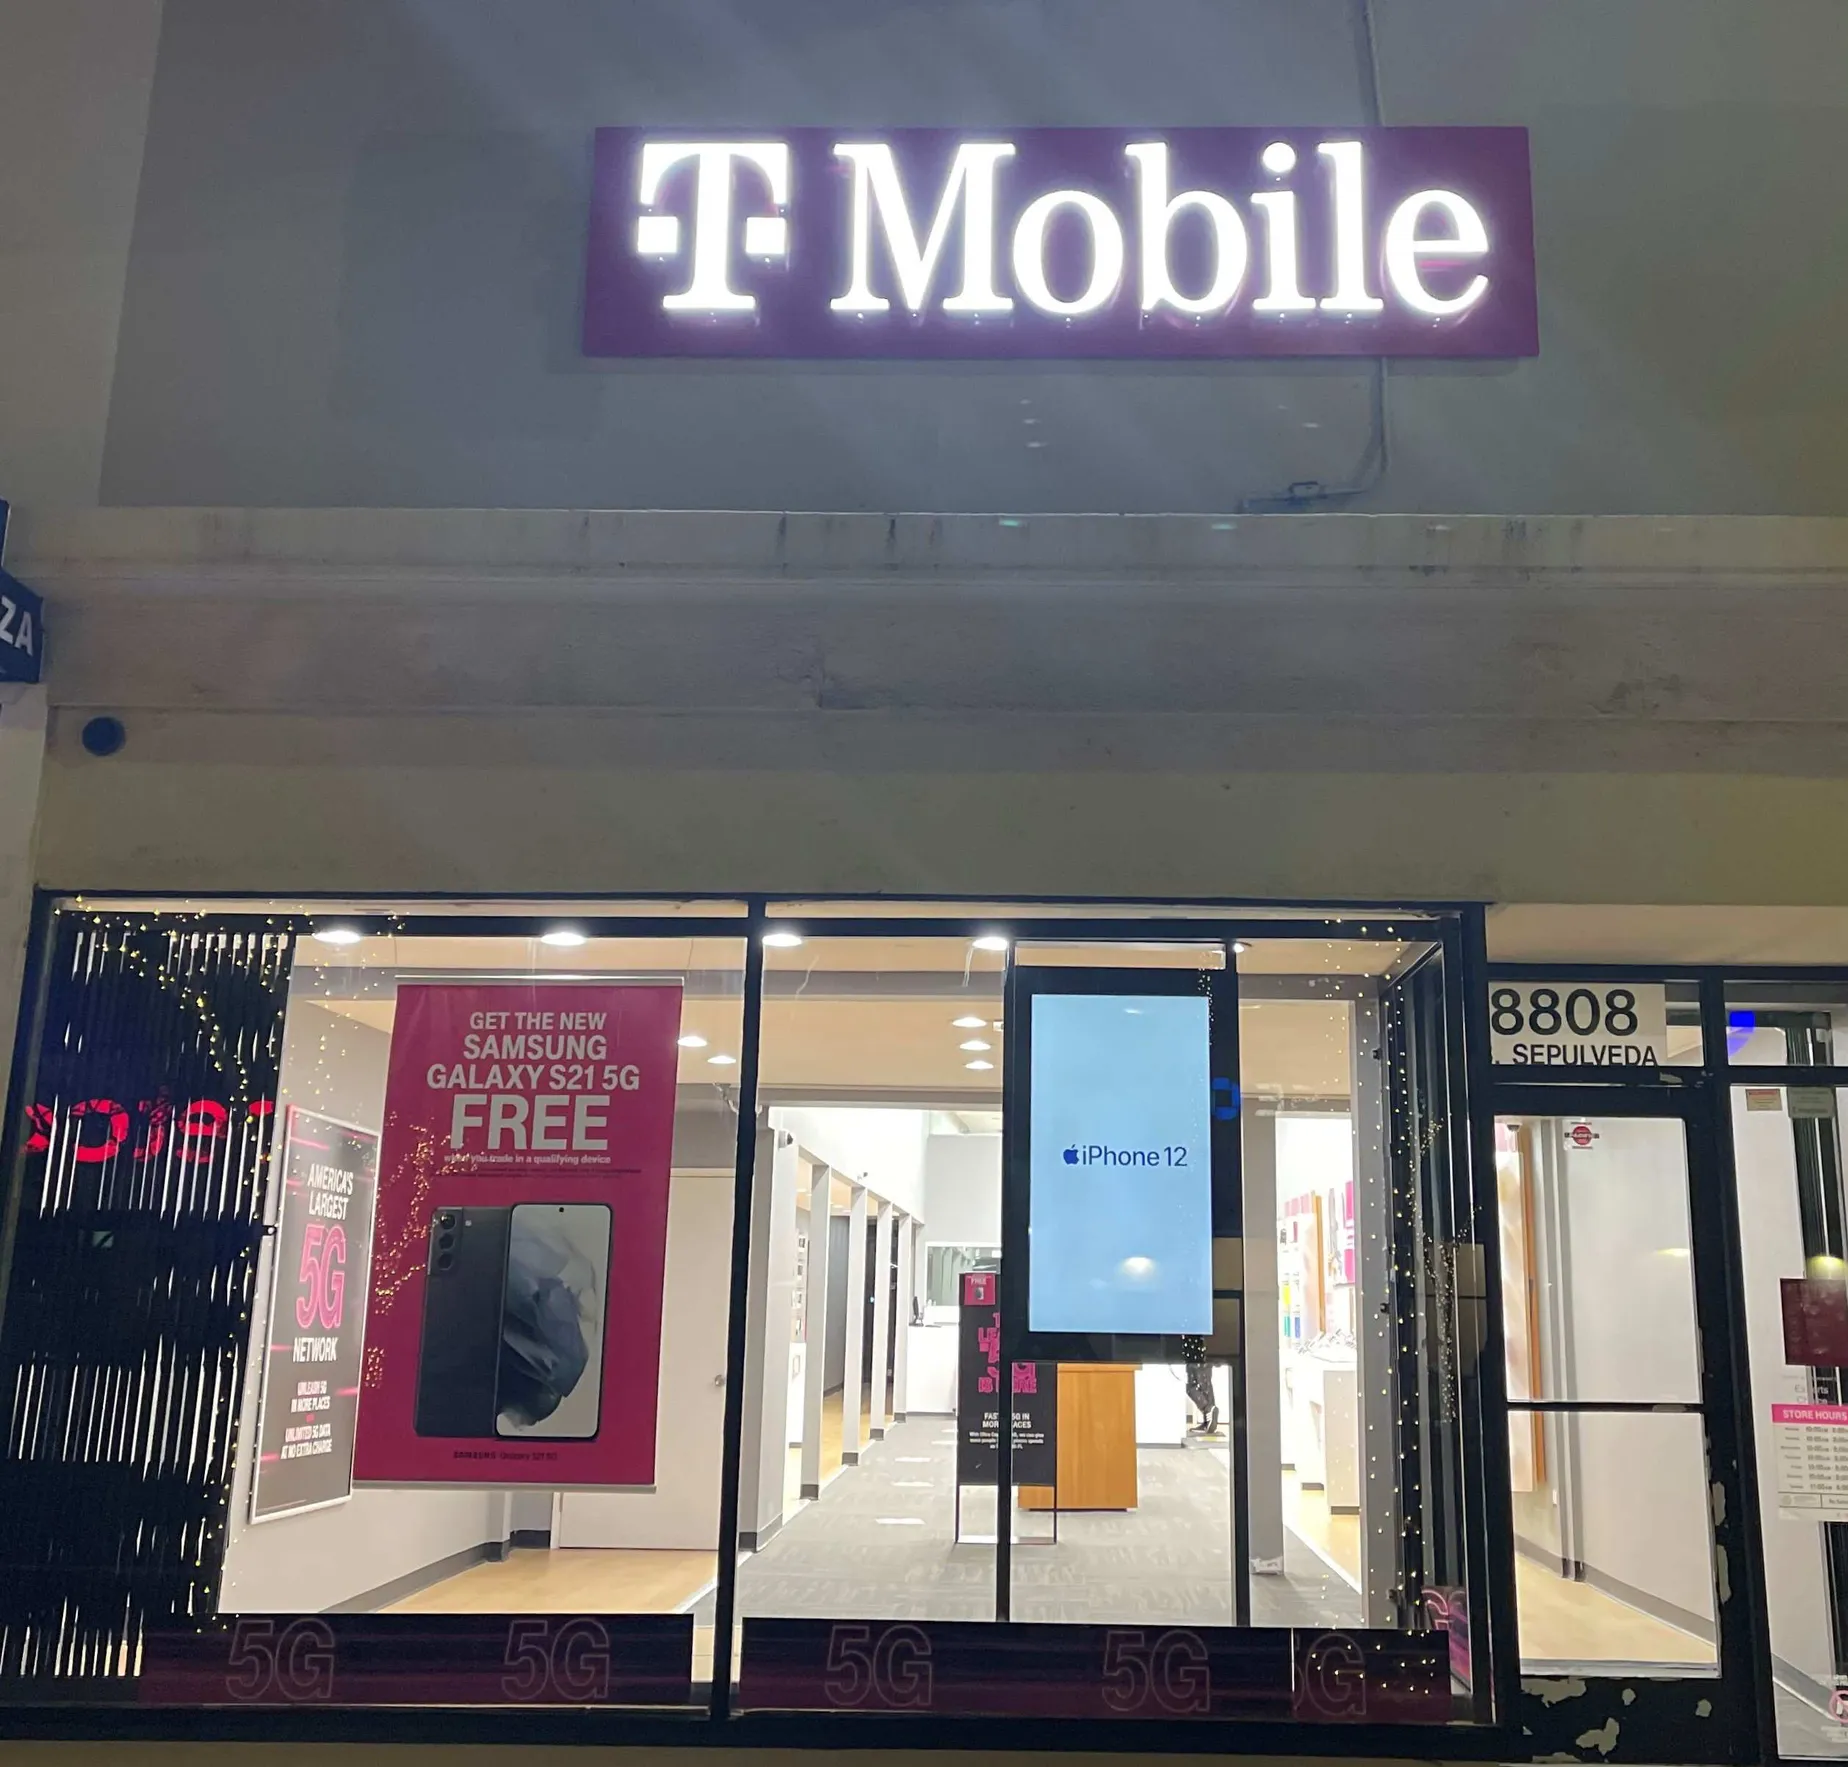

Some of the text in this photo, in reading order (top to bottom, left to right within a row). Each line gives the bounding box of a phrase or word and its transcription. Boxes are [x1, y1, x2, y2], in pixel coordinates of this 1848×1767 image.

[637, 140, 1491, 314] T Mobile
[469, 1011, 607, 1031] GET THE NEW
[1491, 987, 1639, 1037] 8808
[462, 1034, 608, 1061] SAMSUNG
[1511, 1043, 1659, 1067] SEPULVEDA
[426, 1063, 640, 1091] GALAXY S21 5G
[449, 1093, 611, 1151] FREE
[489, 1153, 513, 1164] trade
[515, 1153, 525, 1164] in
[526, 1155, 533, 1164] a
[534, 1153, 579, 1166] qualifying
[580, 1153, 611, 1165] device
[1082, 1145, 1188, 1167] iPhone 12
[307, 1163, 354, 1196] AMERICA'S
[308, 1190, 349, 1221] LARGEST
[295, 1223, 347, 1330] 5G
[292, 1337, 339, 1363] NETWORK
[982, 1420, 999, 1429] MOR
[1022, 1413, 1030, 1421] IN
[1782, 1409, 1848, 1421] STORE HOURS
[225, 1618, 336, 1701] 5G
[501, 1617, 611, 1701] 5G
[823, 1623, 933, 1709] 5G
[1101, 1628, 1211, 1714] 5G
